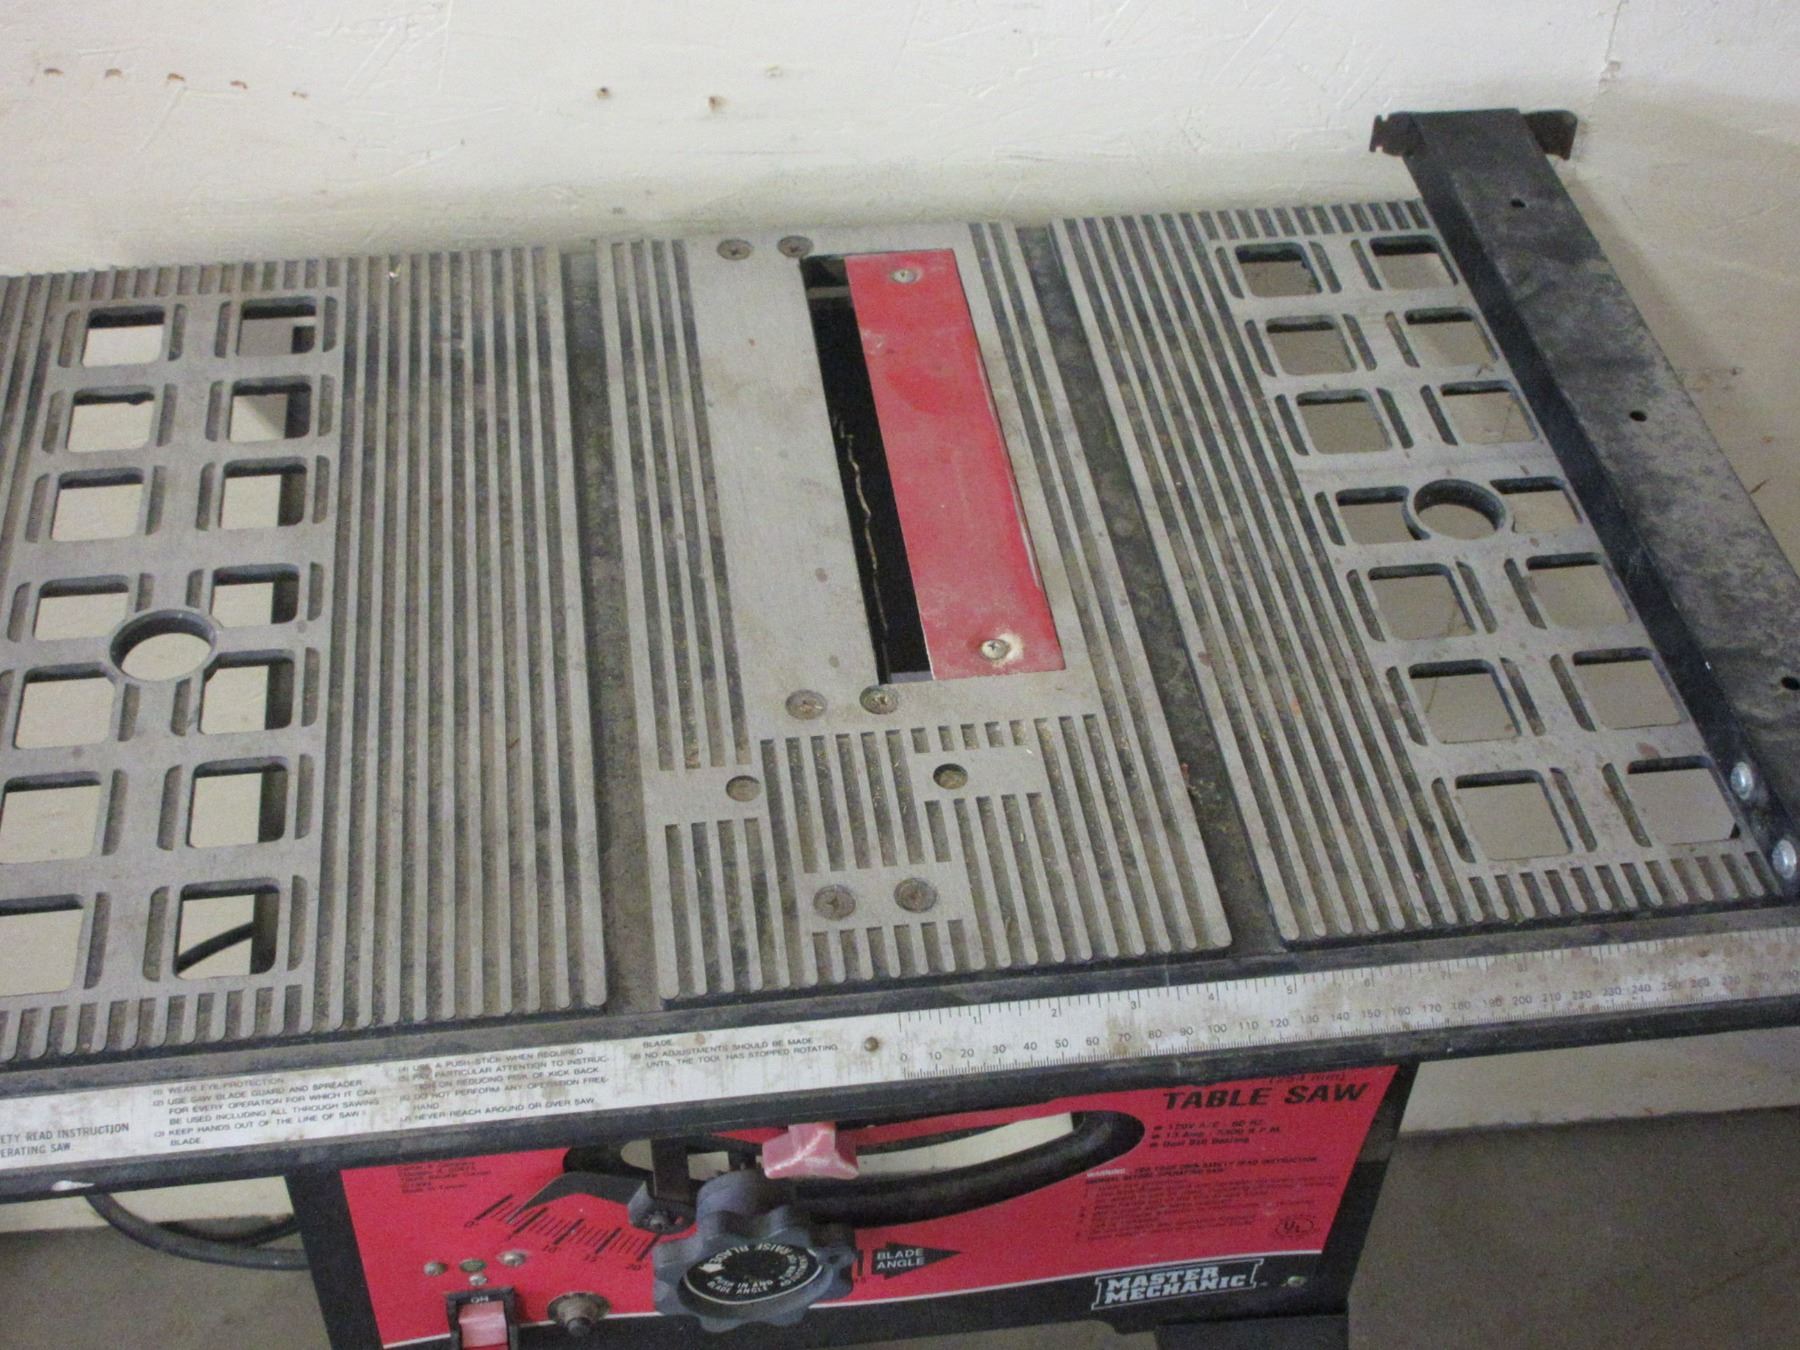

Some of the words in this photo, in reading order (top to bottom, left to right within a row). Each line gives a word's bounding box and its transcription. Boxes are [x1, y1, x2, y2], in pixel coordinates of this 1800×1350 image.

[1051, 1008, 1058, 1017] 2
[1131, 1000, 1137, 1009] 3
[1287, 986, 1293, 994] 5
[900, 1053, 907, 1062] 0
[929, 1051, 942, 1061] 10
[960, 1048, 974, 1058] 20
[992, 1044, 1006, 1054] 30
[1023, 1041, 1037, 1051] 40
[1055, 1038, 1069, 1049] 50
[1086, 1036, 1099, 1046] 60
[1119, 1032, 1131, 1042] 70
[1148, 1029, 1162, 1039] 80
[1180, 1026, 1193, 1036] 90
[1208, 1023, 1227, 1034] 100
[1239, 1020, 1259, 1031] 110
[1269, 1018, 1289, 1028] 120
[1300, 1014, 1320, 1024] 130
[1331, 1011, 1350, 1022] 140
[1362, 1008, 1381, 1018] 150
[1391, 1006, 1411, 1016] 160
[1422, 1003, 1442, 1013] 170
[1452, 1000, 1471, 1010] 180
[1483, 996, 1503, 1007] 190
[1512, 995, 1533, 1006] 200
[1542, 992, 1561, 1002] 210
[1572, 989, 1592, 1000] 220
[1602, 986, 1622, 996] 230
[1631, 983, 1651, 994] 240
[1662, 981, 1681, 991] 250
[642, 1040, 673, 1048] BLADE
[662, 1045, 728, 1056] ADJUSTMENTS
[731, 1041, 768, 1050] SHOULD
[787, 1037, 813, 1045] MADE
[506, 1053, 534, 1062] WHEN
[537, 1048, 584, 1059] REQUIRED
[646, 1060, 671, 1069] UNTIL
[678, 1057, 693, 1065] THE
[699, 1055, 720, 1063] TOOL
[726, 1052, 745, 1060] HAS
[749, 1048, 790, 1058] STOPPED
[434, 1067, 492, 1077] PARTICULAR
[496, 1062, 547, 1072] ATTENTION
[552, 1059, 564, 1067] TO
[456, 1075, 504, 1086] REDUCING
[533, 1071, 544, 1079] OF
[548, 1069, 569, 1077] KICK
[574, 1067, 599, 1075] BACK
[168, 1086, 196, 1094] WEAR
[168, 1097, 186, 1105] USE
[191, 1095, 212, 1103] SAW
[216, 1090, 247, 1101] BLADE
[251, 1087, 284, 1097] GUARD
[289, 1085, 309, 1093] AND
[312, 1080, 362, 1091] SPREADER
[455, 1086, 501, 1096] PERFORM
[527, 1078, 579, 1090] OPERATION
[1163, 1087, 1272, 1110] TABLE
[1283, 1082, 1370, 1104] SAW
[169, 1106, 189, 1115] FOR
[192, 1103, 223, 1113] EVERY
[228, 1098, 282, 1109] OPERATION
[286, 1095, 305, 1103] FOR
[309, 1092, 341, 1101] WHICH
[356, 1089, 377, 1097] CAN
[413, 1102, 440, 1110] HAND
[414, 1111, 446, 1120] NEVER
[449, 1108, 481, 1117] REACH
[484, 1103, 524, 1114] AROUND
[528, 1101, 542, 1110] OR
[545, 1100, 571, 1108] OVER
[168, 1127, 194, 1136] KEEP
[197, 1124, 231, 1133] HANDS
[234, 1121, 254, 1130] OUT
[276, 1117, 292, 1125] THE
[297, 1115, 318, 1123] LINE
[338, 1110, 360, 1119] SAW
[169, 1118, 181, 1126] BE
[187, 1114, 212, 1124] USED
[216, 1110, 266, 1120] INCLUDING
[270, 1107, 287, 1115] ALL
[293, 1103, 339, 1113] THROUGH
[26, 1131, 53, 1142] READ
[57, 1122, 130, 1139] INSTRUCTION
[0, 1145, 46, 1158] ERATING
[876, 1247, 924, 1260] BLADE
[876, 1257, 925, 1270] ANGLE
[707, 1280, 731, 1294] BLADE
[736, 1285, 768, 1295] ANGLE
[753, 1280, 774, 1289] AND
[1107, 1266, 1219, 1291] MASTER
[1104, 1274, 1247, 1305] MECHANIC
